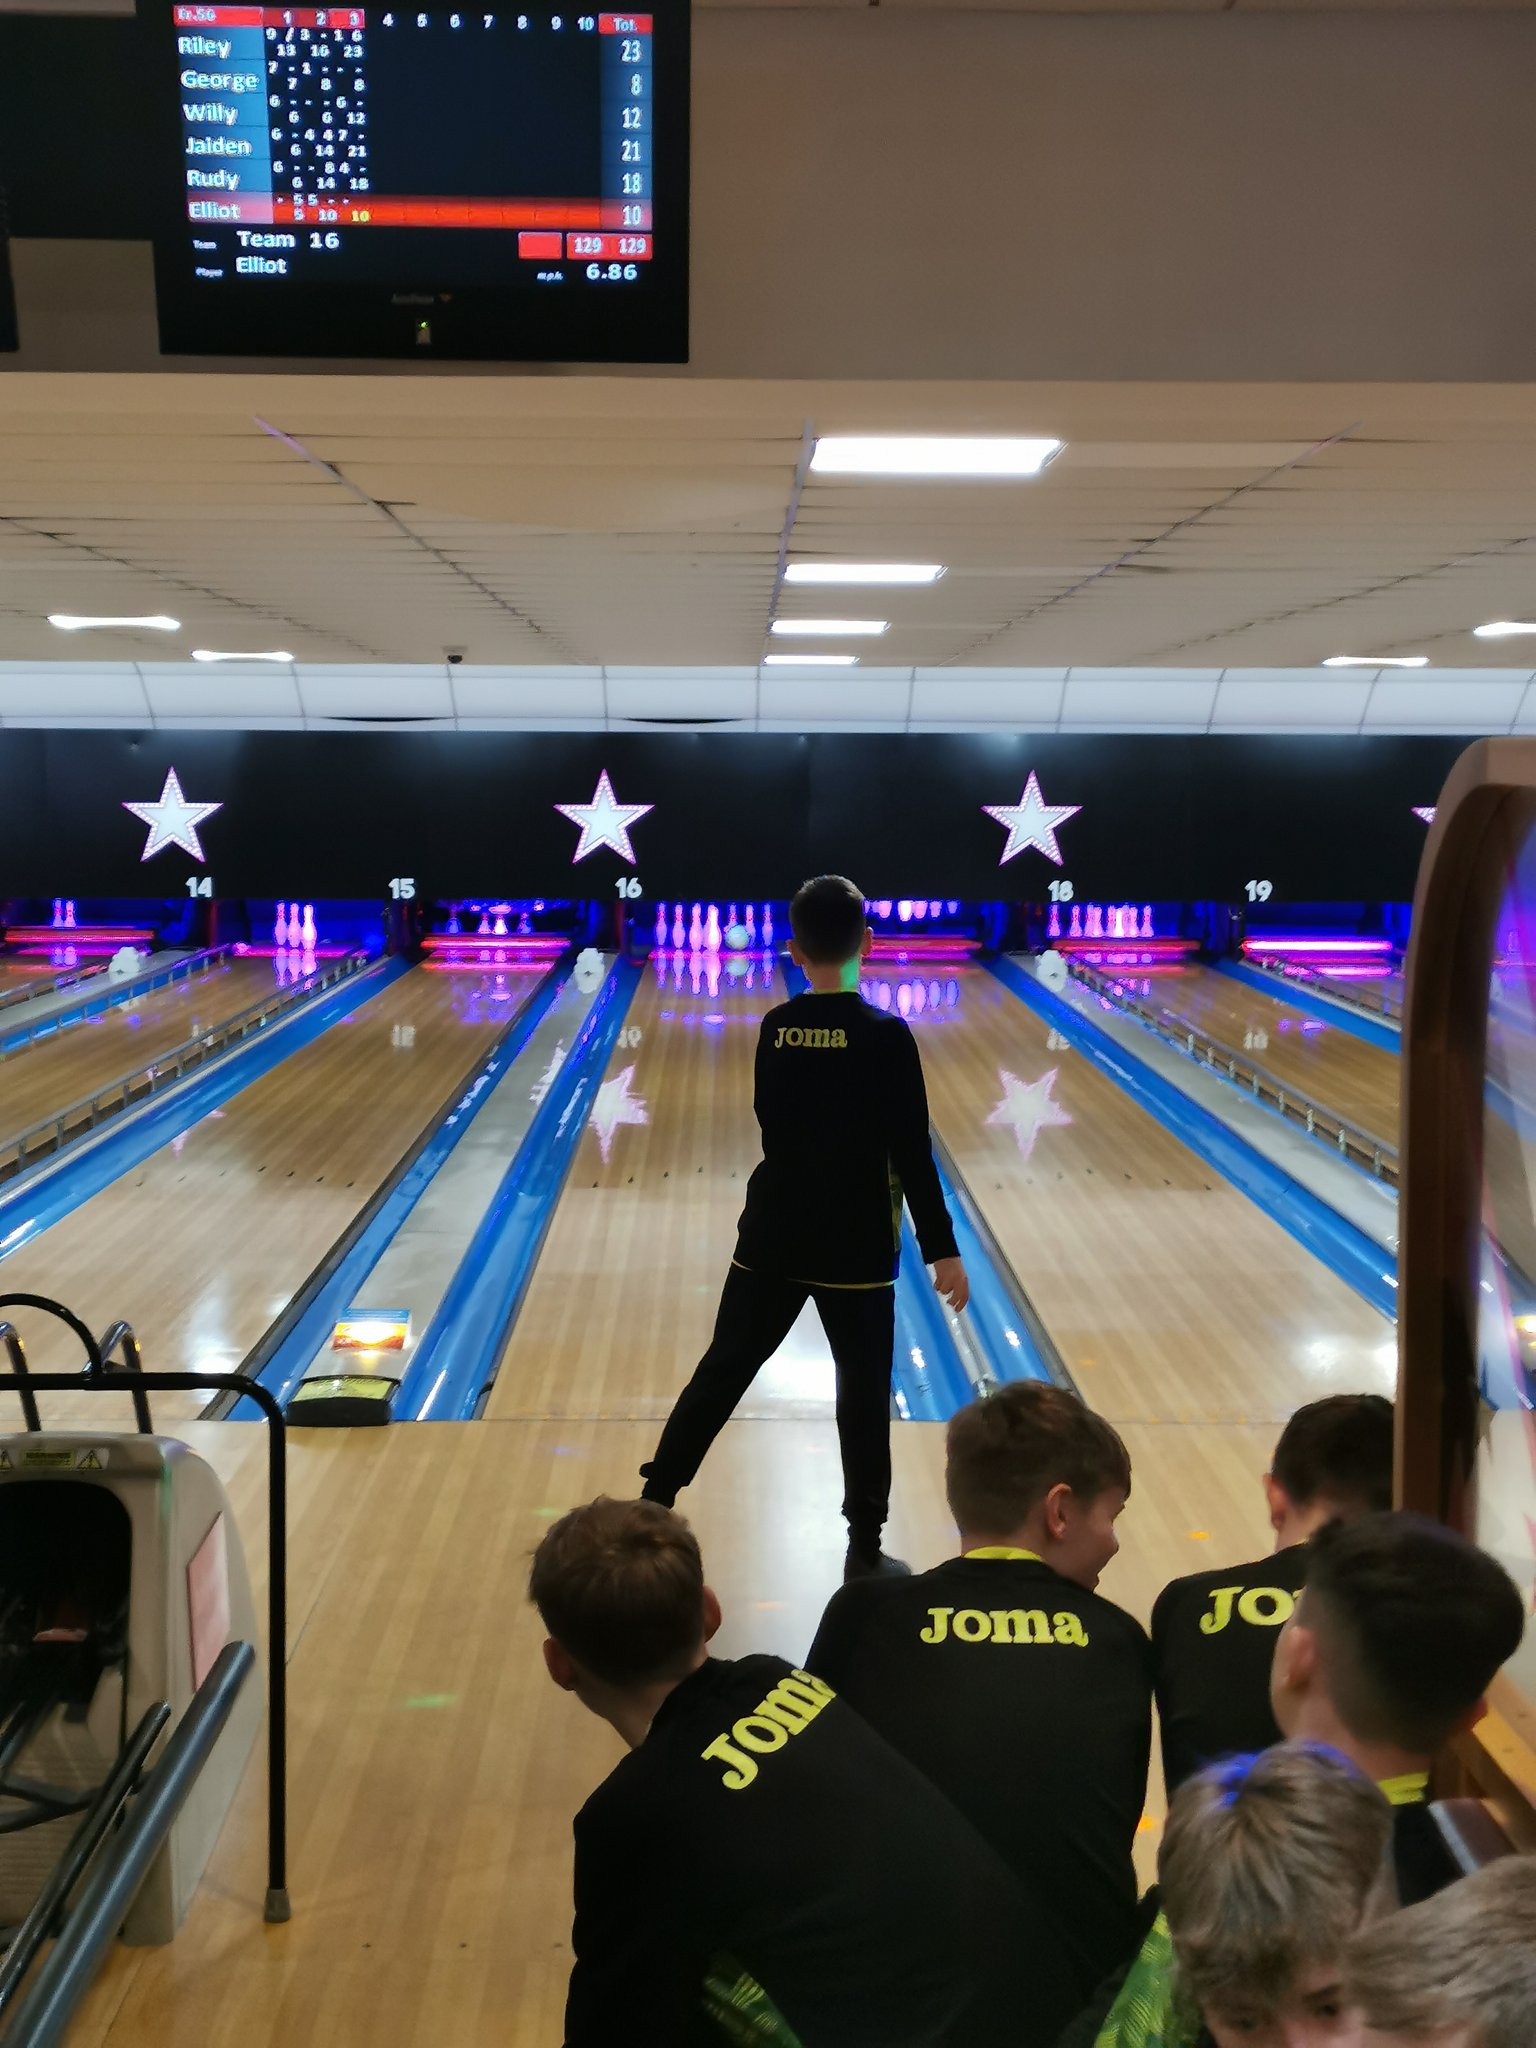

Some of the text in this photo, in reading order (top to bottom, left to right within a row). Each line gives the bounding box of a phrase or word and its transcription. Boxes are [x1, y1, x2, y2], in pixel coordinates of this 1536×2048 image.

[316, 11, 326, 26] 2
[349, 12, 359, 26] 3
[382, 13, 394, 27] 4
[417, 13, 427, 28] 5
[450, 14, 460, 28] 6
[483, 15, 494, 28] 7
[517, 15, 528, 29] 8
[551, 16, 562, 30] 9
[578, 16, 594, 30] 10
[178, 36, 231, 58] Riley
[621, 40, 641, 62] 23
[181, 70, 258, 93] George
[630, 74, 641, 96] 8
[183, 103, 238, 125] Willy
[622, 108, 641, 128] 12
[186, 136, 251, 156] Jaiden
[621, 140, 641, 162] 21
[187, 170, 239, 190] Rudy
[622, 173, 642, 194] 18
[188, 201, 240, 219] Elliot
[351, 210, 370, 222] 10
[622, 206, 642, 226] 10
[236, 231, 340, 248] Team 16
[574, 238, 646, 254] 129 129
[236, 256, 287, 274] Elliot
[586, 263, 638, 280] 6.86
[185, 876, 212, 897] 14
[388, 878, 415, 899] 15
[615, 877, 643, 899] 16
[1047, 880, 1074, 902] 18
[1244, 880, 1273, 902] 19
